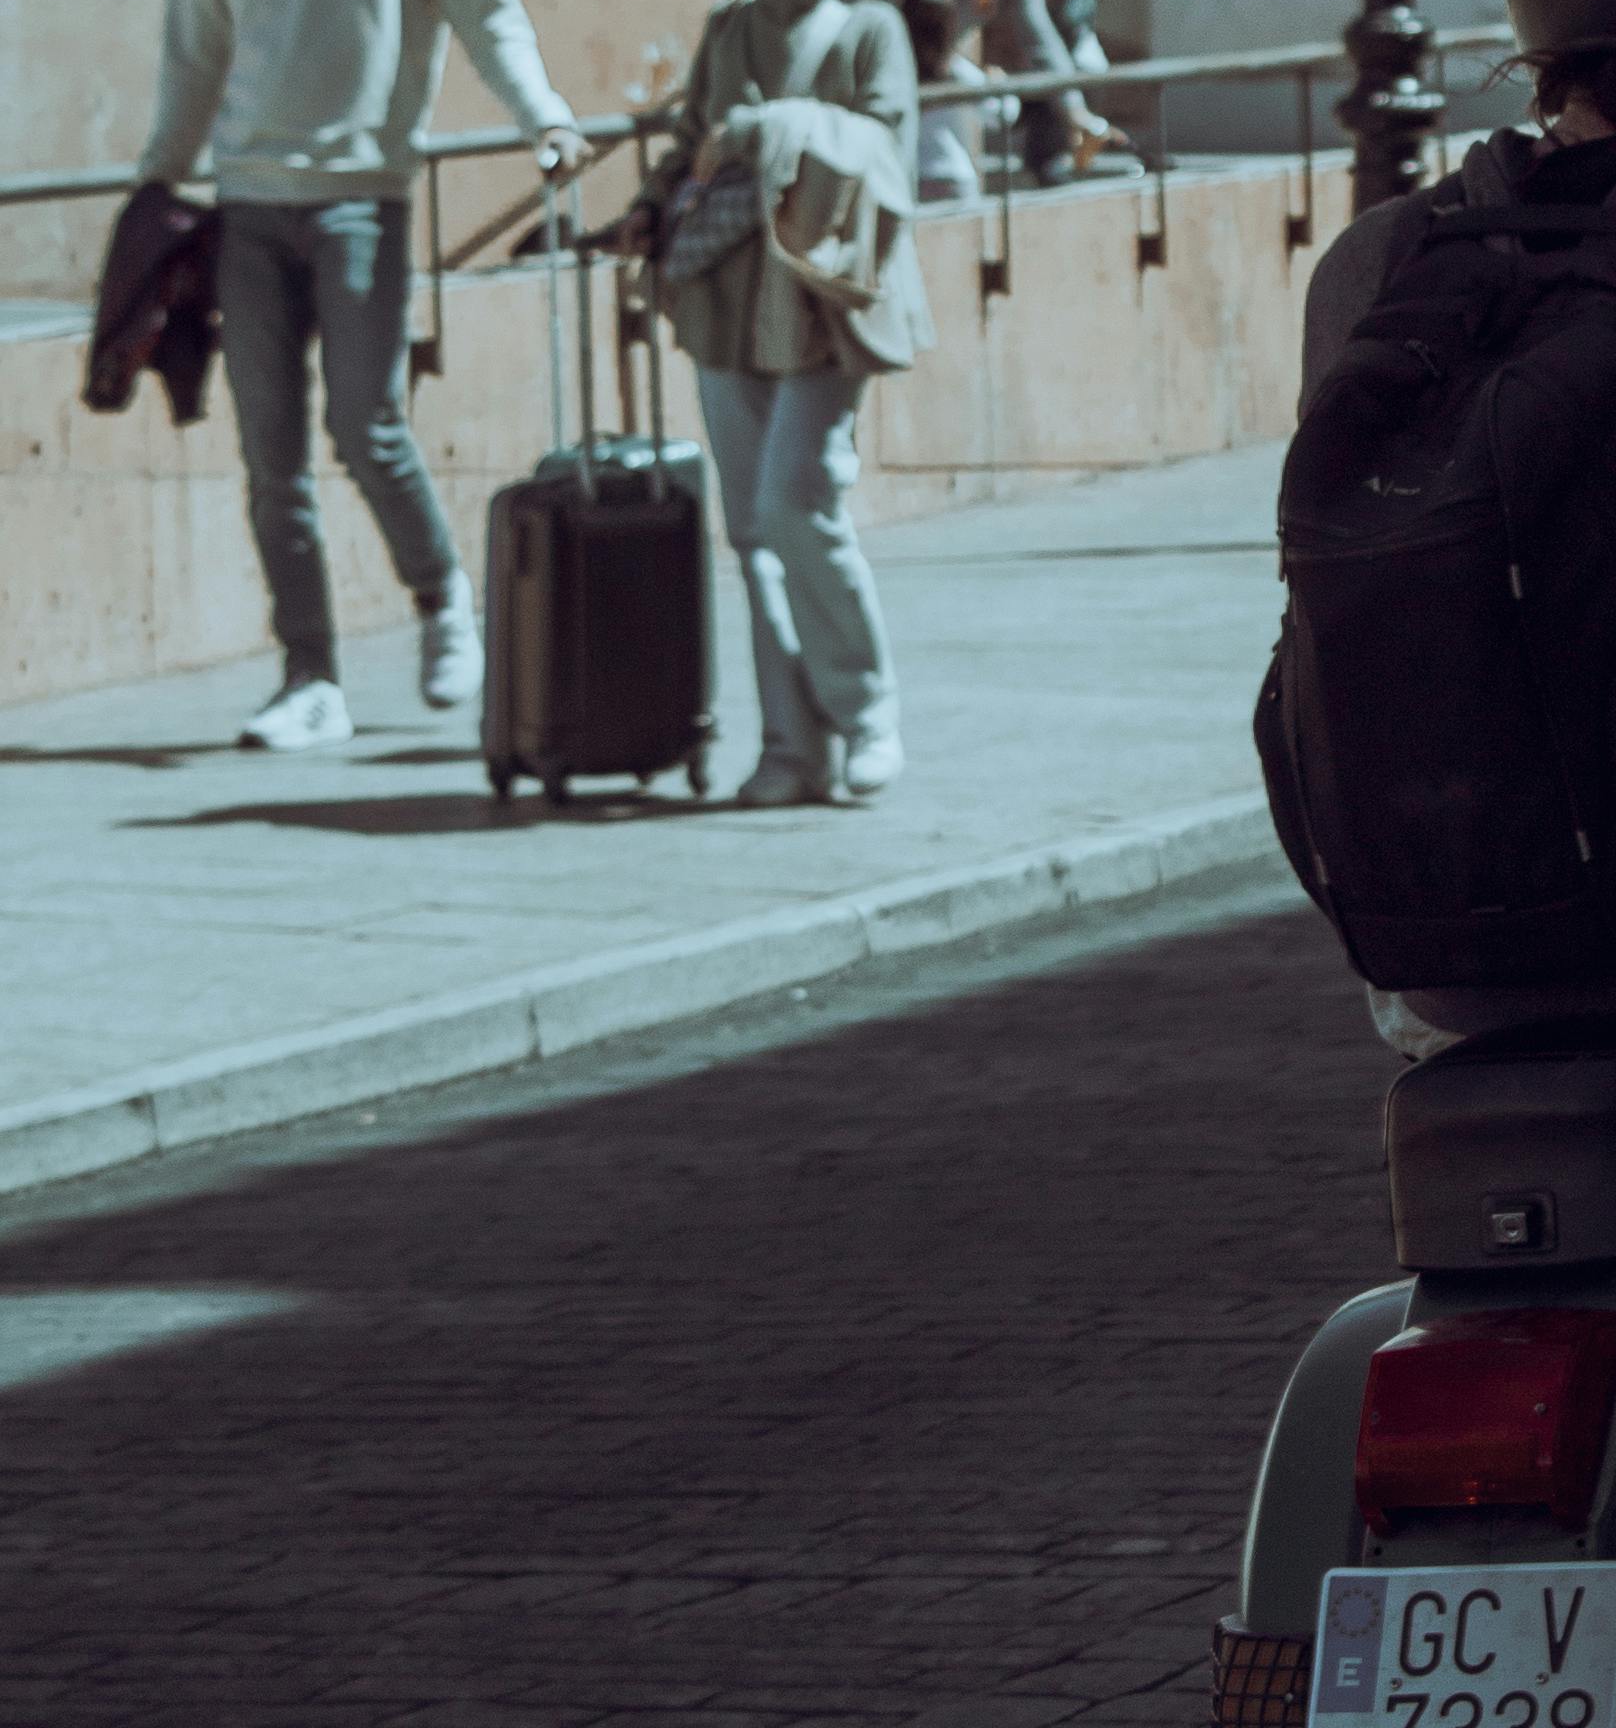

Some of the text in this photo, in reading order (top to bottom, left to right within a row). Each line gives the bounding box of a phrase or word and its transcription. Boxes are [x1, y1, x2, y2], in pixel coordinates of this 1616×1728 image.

[1399, 1586, 1586, 1676] GC V
[1337, 1658, 1363, 1687] E
